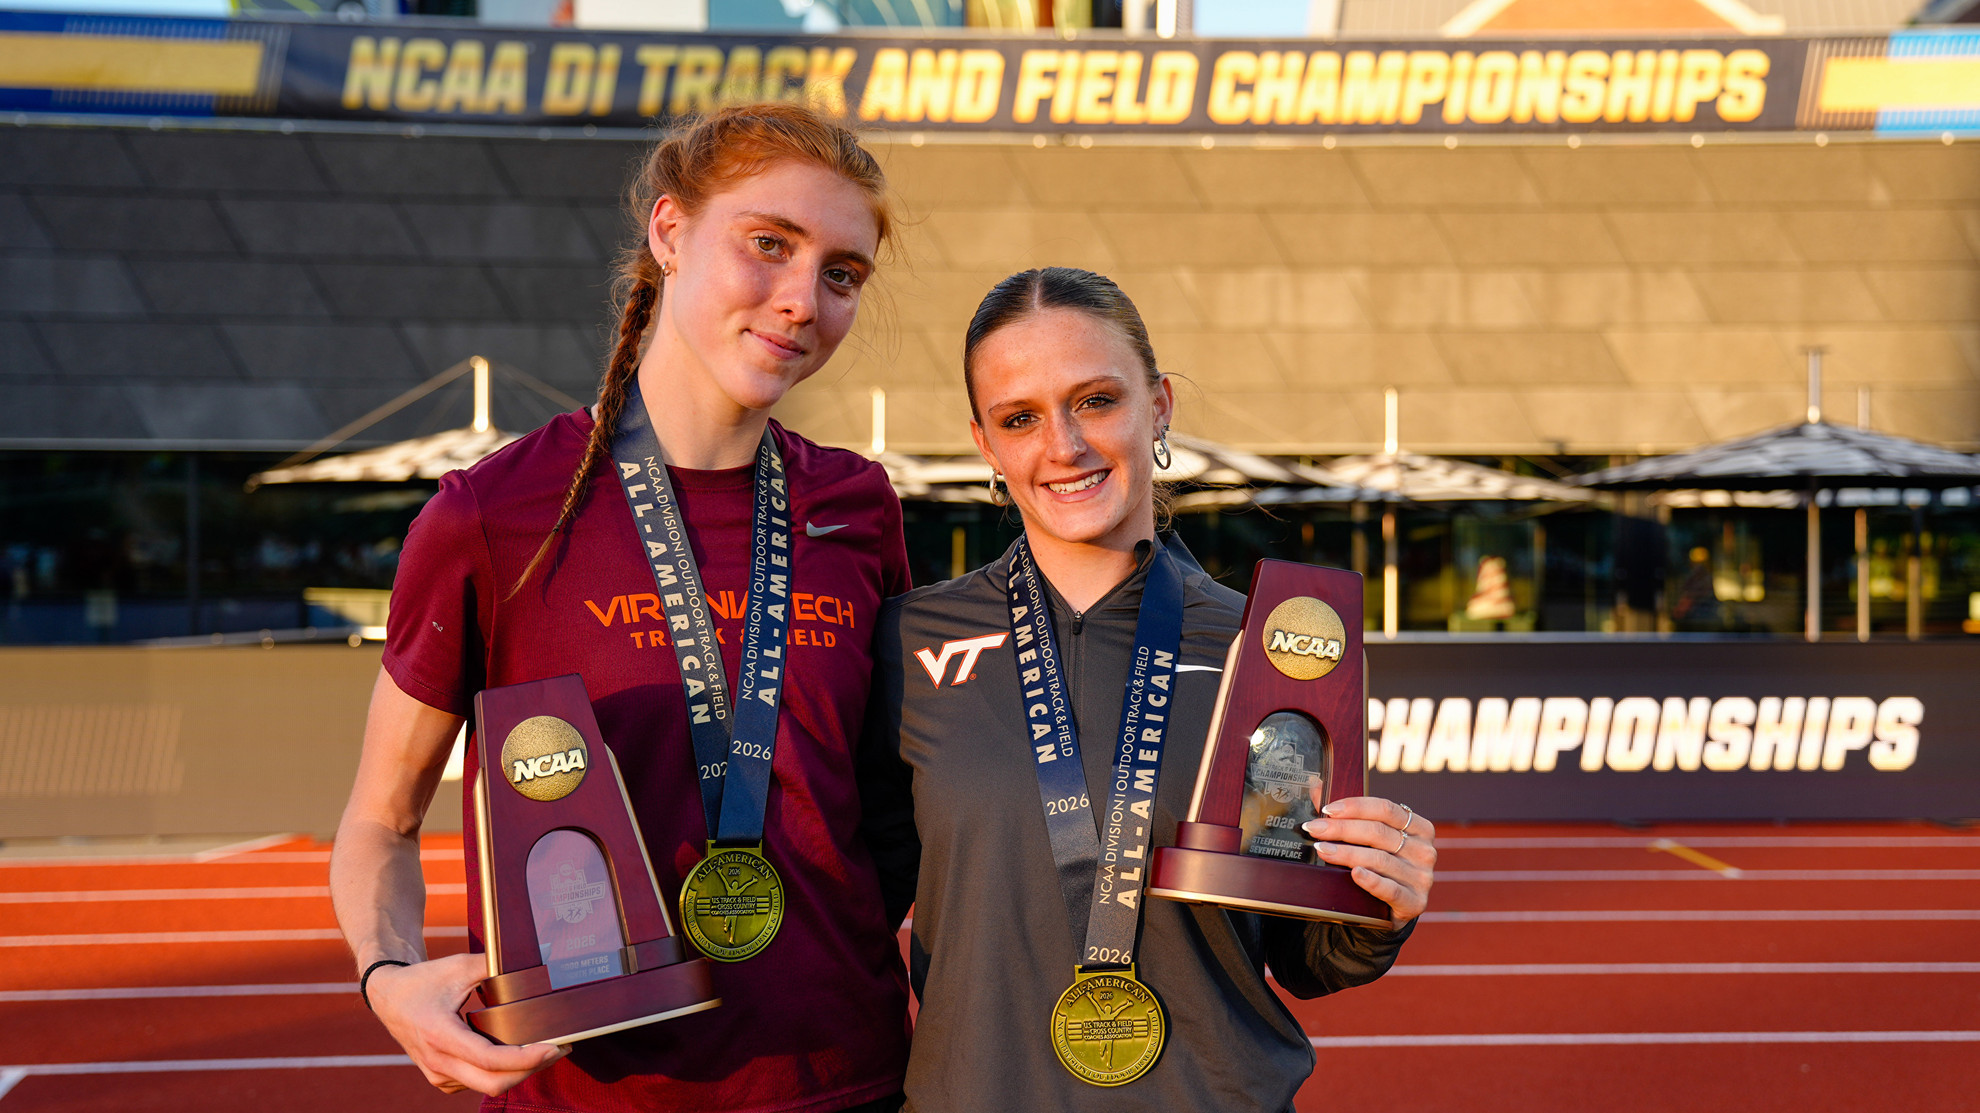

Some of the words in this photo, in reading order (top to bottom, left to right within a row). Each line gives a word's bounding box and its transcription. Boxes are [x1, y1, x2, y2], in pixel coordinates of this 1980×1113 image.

[341, 36, 528, 115] NCAA
[541, 43, 622, 116] DI
[635, 44, 857, 120] TRACK
[858, 47, 1005, 123] AND
[1012, 50, 1199, 124] FIELD
[1207, 49, 1771, 125] CHAMPIONSHIPS
[645, 456, 664, 494] NCAA
[760, 445, 769, 478] FIELD
[758, 480, 768, 488] &
[657, 495, 684, 552] DIVISION
[757, 490, 768, 526] TRACK
[753, 528, 767, 594] OUTDOOR
[619, 462, 711, 725] ALL-AMERICAN
[678, 559, 706, 628] OUTDOOR
[758, 452, 788, 707] ALL-AMERICAN
[1022, 557, 1042, 610] DIVISION
[584, 591, 748, 628] VIRNI
[790, 593, 855, 629] ECH
[631, 628, 726, 649] TRK
[786, 629, 836, 648] IELD
[747, 600, 763, 659] DIVISION
[1269, 630, 1340, 661] NCAA
[698, 628, 718, 671] TRACK
[913, 632, 1010, 689] VT
[1008, 554, 1057, 764] LL-AMERICAN
[1036, 615, 1057, 681] OUTDOOR
[1134, 646, 1149, 677] FIELD
[708, 673, 719, 682] &
[742, 662, 757, 700] NCAA
[1133, 677, 1145, 686] &
[711, 684, 726, 720] FIELD
[1048, 681, 1067, 714] TRACK
[1126, 686, 1142, 724] TRACK
[1056, 715, 1067, 724] &
[732, 740, 772, 761] 2026
[1056, 725, 1074, 757] FIELD
[513, 748, 586, 783] NCAA
[700, 761, 728, 780] 202
[1116, 726, 1136, 792] OUTDOOR
[1255, 768, 1310, 783] CHAMPIONSHIP
[1116, 650, 1174, 910] ALL-AMERICAN
[1047, 793, 1089, 816] 2026
[1265, 815, 1296, 829] 2026
[1105, 807, 1124, 862] DIVISION
[1252, 836, 1302, 850] STEEPLECHASE
[696, 854, 773, 882] ALL-AMERICAN
[1249, 846, 1280, 857] SEVENTH
[1280, 850, 1302, 859] PLACE
[1100, 864, 1115, 904] NCAA
[567, 934, 597, 951] 2026
[1088, 946, 1132, 965] 2026
[580, 955, 609, 967] METERS
[1065, 978, 1149, 1007] ALL-AMERICAN
